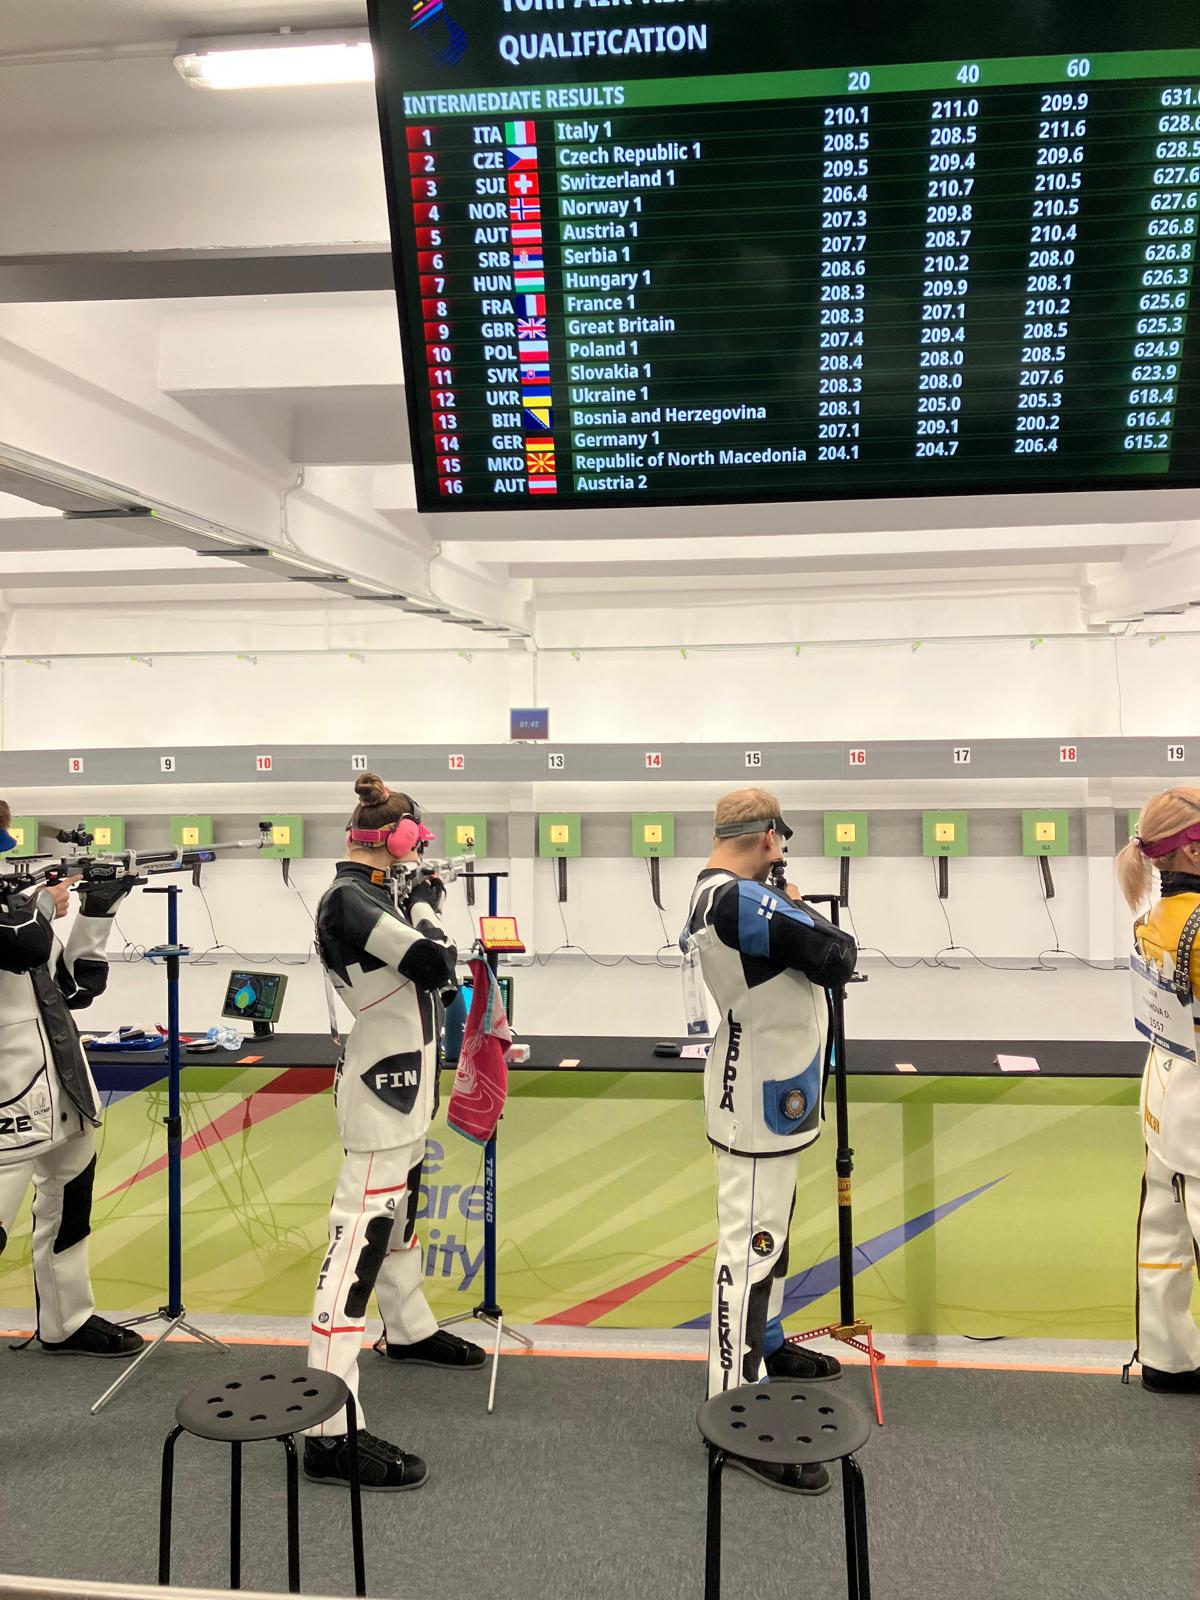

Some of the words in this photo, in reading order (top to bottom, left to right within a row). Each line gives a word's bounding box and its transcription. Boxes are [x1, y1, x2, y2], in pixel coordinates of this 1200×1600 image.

[500, 24, 706, 65] QUALIFICATION
[403, 91, 541, 115] INTERMEDIATE
[546, 86, 624, 108] RESULTS
[848, 72, 870, 90] 20
[957, 64, 979, 83] 40
[1067, 59, 1090, 77] 60
[422, 129, 431, 146] 1
[474, 126, 502, 143] ITA
[558, 121, 598, 143] Italy
[603, 121, 611, 137] 1
[825, 106, 868, 125] 210.1
[932, 99, 978, 118] 211.0
[1041, 93, 1088, 112] 209.9
[424, 155, 435, 171] 2
[474, 152, 503, 169] CZE
[560, 147, 608, 165] Czech
[614, 143, 687, 166] Republic
[693, 143, 700, 158] 1
[824, 133, 868, 151] 208.5
[931, 126, 976, 145] 208.5
[1039, 120, 1085, 138] 211.6
[427, 181, 437, 196] 3
[476, 177, 506, 194] SUI
[561, 170, 661, 190] Switzerland
[667, 170, 674, 185] 1
[824, 159, 868, 177] 209.5
[929, 153, 975, 171] 209.4
[1037, 147, 1083, 165] 209.6
[429, 205, 439, 221] 4
[469, 203, 507, 219] NOR
[562, 199, 629, 217] Norway
[634, 197, 641, 212] 1
[823, 185, 867, 203] 206.4
[928, 179, 974, 197] 210.7
[1035, 173, 1081, 191] 210.5
[1154, 167, 1200, 184] 627.6
[431, 230, 441, 245] 5
[475, 227, 508, 243] AUT
[563, 222, 625, 240] Austria
[630, 222, 637, 236] 1
[823, 211, 866, 228] 207.3
[927, 205, 971, 222] 209.8
[1033, 199, 1078, 216] 210.5
[1151, 193, 1197, 210] 627.6
[433, 254, 443, 269] 6
[479, 252, 510, 267] SRB
[564, 247, 617, 264] Serbia
[622, 247, 629, 261] 1
[822, 236, 866, 252] 207.7
[926, 230, 971, 247] 208.7
[1031, 224, 1077, 242] 210.4
[1148, 218, 1194, 235] 626.8
[435, 278, 444, 293] 7
[474, 275, 511, 291] HUN
[566, 273, 638, 291] Hungary
[643, 270, 650, 284] 1
[822, 260, 865, 277] 208.6
[925, 255, 969, 272] 210.2
[1029, 250, 1074, 267] 208.0
[1145, 244, 1191, 260] 626.8
[437, 302, 447, 316] 8
[482, 299, 514, 314] FRA
[568, 297, 622, 312] France
[627, 295, 634, 309] 1
[821, 284, 864, 301] 208.3
[924, 280, 967, 296] 209.9
[1027, 275, 1071, 291] 208.1
[1143, 269, 1188, 285] 626.3
[439, 325, 449, 339] 9
[482, 322, 515, 337] GBR
[568, 320, 614, 335] Great
[619, 316, 674, 333] Britain
[821, 308, 864, 324] 208.3
[923, 304, 964, 320] 207.1
[1025, 299, 1070, 315] 210.2
[1140, 293, 1185, 310] 625.6
[433, 347, 451, 362] 10
[485, 345, 516, 360] POL
[570, 340, 625, 357] Poland
[630, 341, 637, 355] 1
[821, 332, 863, 347] 207.4
[921, 327, 965, 343] 209.4
[1024, 322, 1067, 338] 208.5
[1137, 317, 1182, 333] 625.3
[435, 370, 451, 384] 11
[488, 366, 519, 383] SVK
[571, 364, 638, 380] Slovakia
[643, 364, 650, 377] 1
[820, 355, 863, 370] 208.4
[920, 351, 963, 366] 208.0
[1022, 346, 1065, 362] 208.5
[1134, 341, 1179, 357] 624.9
[437, 392, 455, 407] 12
[487, 391, 519, 405] UKR
[572, 387, 636, 403] Ukraine
[641, 387, 647, 400] 1
[820, 378, 862, 393] 208.3
[919, 374, 962, 389] 208.0
[1020, 370, 1063, 385] 207.6
[1132, 365, 1176, 381] 623.9
[439, 415, 457, 429] 13
[492, 413, 521, 427] BIH
[574, 409, 626, 425] Bosnia
[631, 408, 660, 423] and
[666, 405, 766, 424] Herzegovina
[819, 401, 859, 416] 208.1
[918, 397, 961, 412] 205.0
[1018, 393, 1061, 408] 205.3
[1130, 388, 1173, 404] 618.4
[441, 437, 459, 450] 14
[493, 435, 523, 449] GER
[575, 433, 647, 449] Germany
[652, 431, 659, 444] 1
[819, 423, 859, 438] 207.1
[917, 419, 958, 434] 209.1
[1017, 415, 1059, 430] 200.2
[1127, 411, 1170, 426] 616.4
[443, 459, 461, 472] 15
[488, 457, 524, 471] MKD
[576, 453, 643, 472] Republic
[648, 452, 664, 466] of
[668, 451, 714, 466] North
[720, 447, 806, 464] Macedonia
[818, 446, 858, 460] 204.1
[916, 442, 958, 456] 204.7
[1015, 438, 1057, 452] 206.4
[1125, 434, 1168, 449] 615.2
[445, 480, 462, 493] 16
[494, 479, 525, 492] AUT
[577, 475, 634, 490] Austria
[638, 475, 647, 488] 2
[73, 760, 80, 771] 8
[164, 758, 172, 770] 9
[257, 757, 271, 769] 10
[353, 757, 366, 769] 11
[449, 756, 464, 768] 12
[549, 755, 563, 767] 13
[646, 754, 661, 767] 14
[745, 753, 760, 765] 15
[850, 751, 865, 763] 16
[955, 750, 969, 762] 17
[1060, 748, 1076, 760] 18
[1169, 747, 1184, 759] 19
[375, 1070, 418, 1090] FIN
[719, 1008, 742, 1113] LEPPÄ
[717, 1264, 734, 1391] ALEKSI
